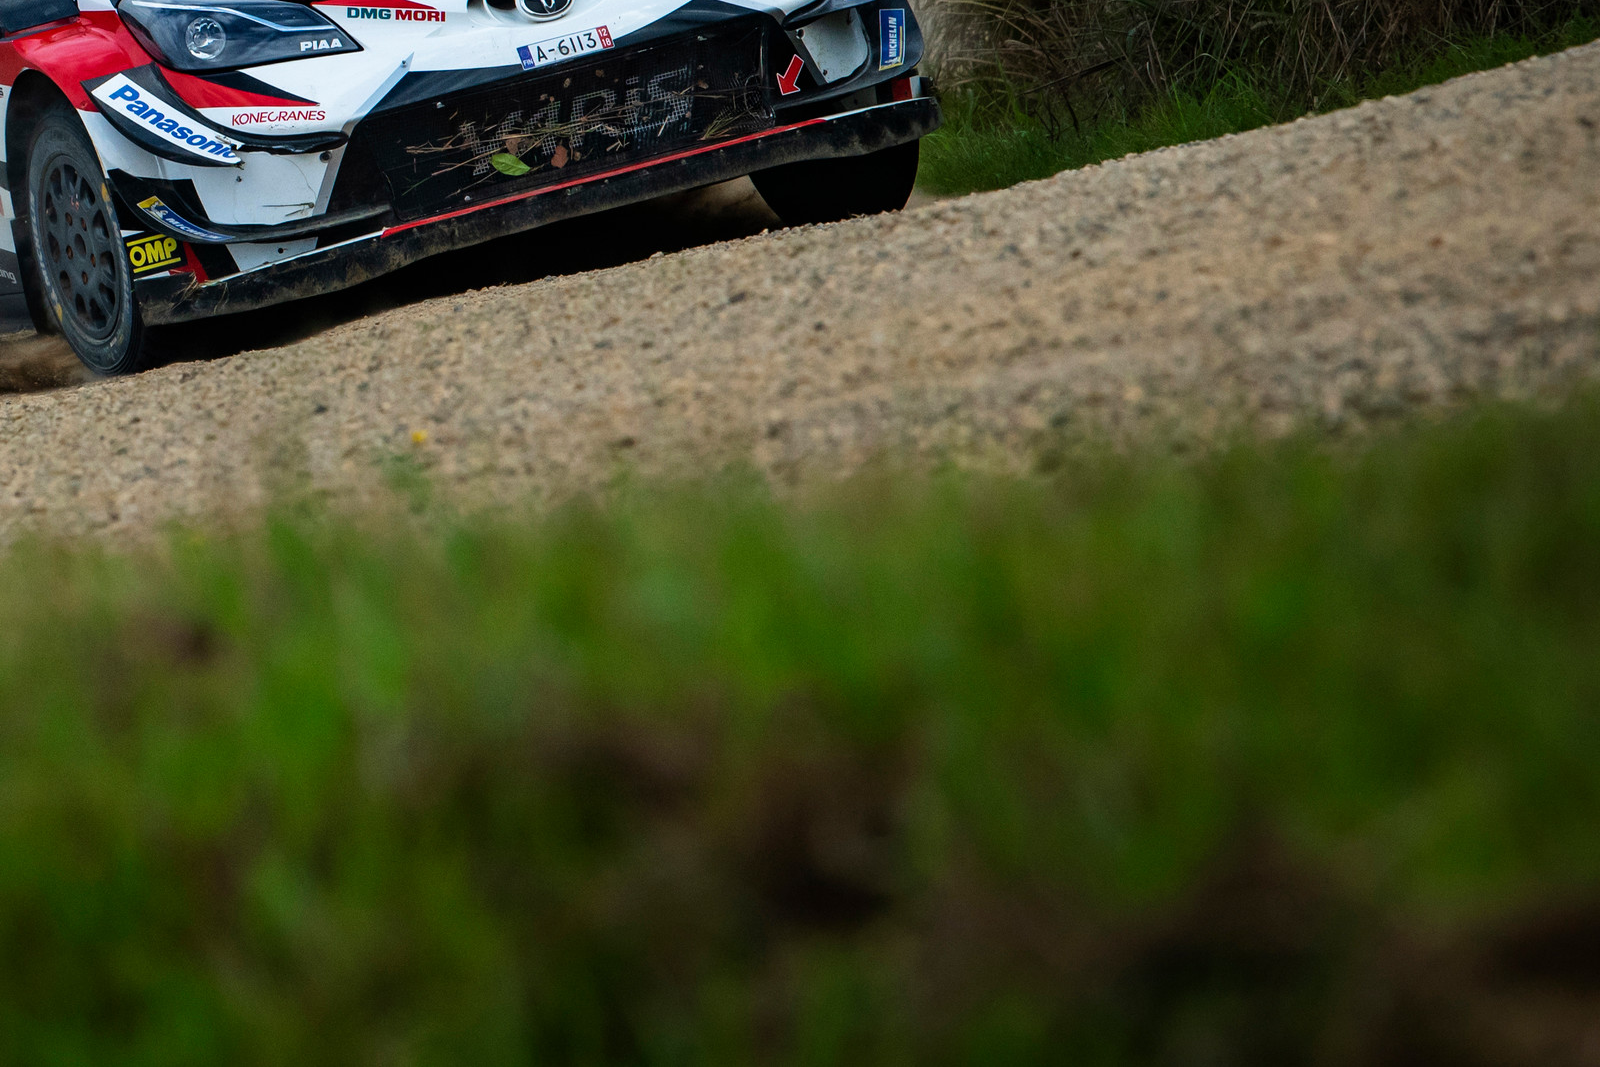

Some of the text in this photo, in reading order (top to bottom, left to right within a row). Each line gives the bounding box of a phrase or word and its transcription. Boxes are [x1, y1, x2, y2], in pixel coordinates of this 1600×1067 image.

[347, 7, 446, 22] DMG MORI
[597, 27, 608, 37] 12
[889, 16, 897, 58] MICHELIN
[300, 36, 343, 51] PIAA
[536, 32, 597, 63] A-6113
[601, 37, 613, 47] 18
[232, 110, 326, 126] KONECRANES
[129, 237, 177, 267] OMP
